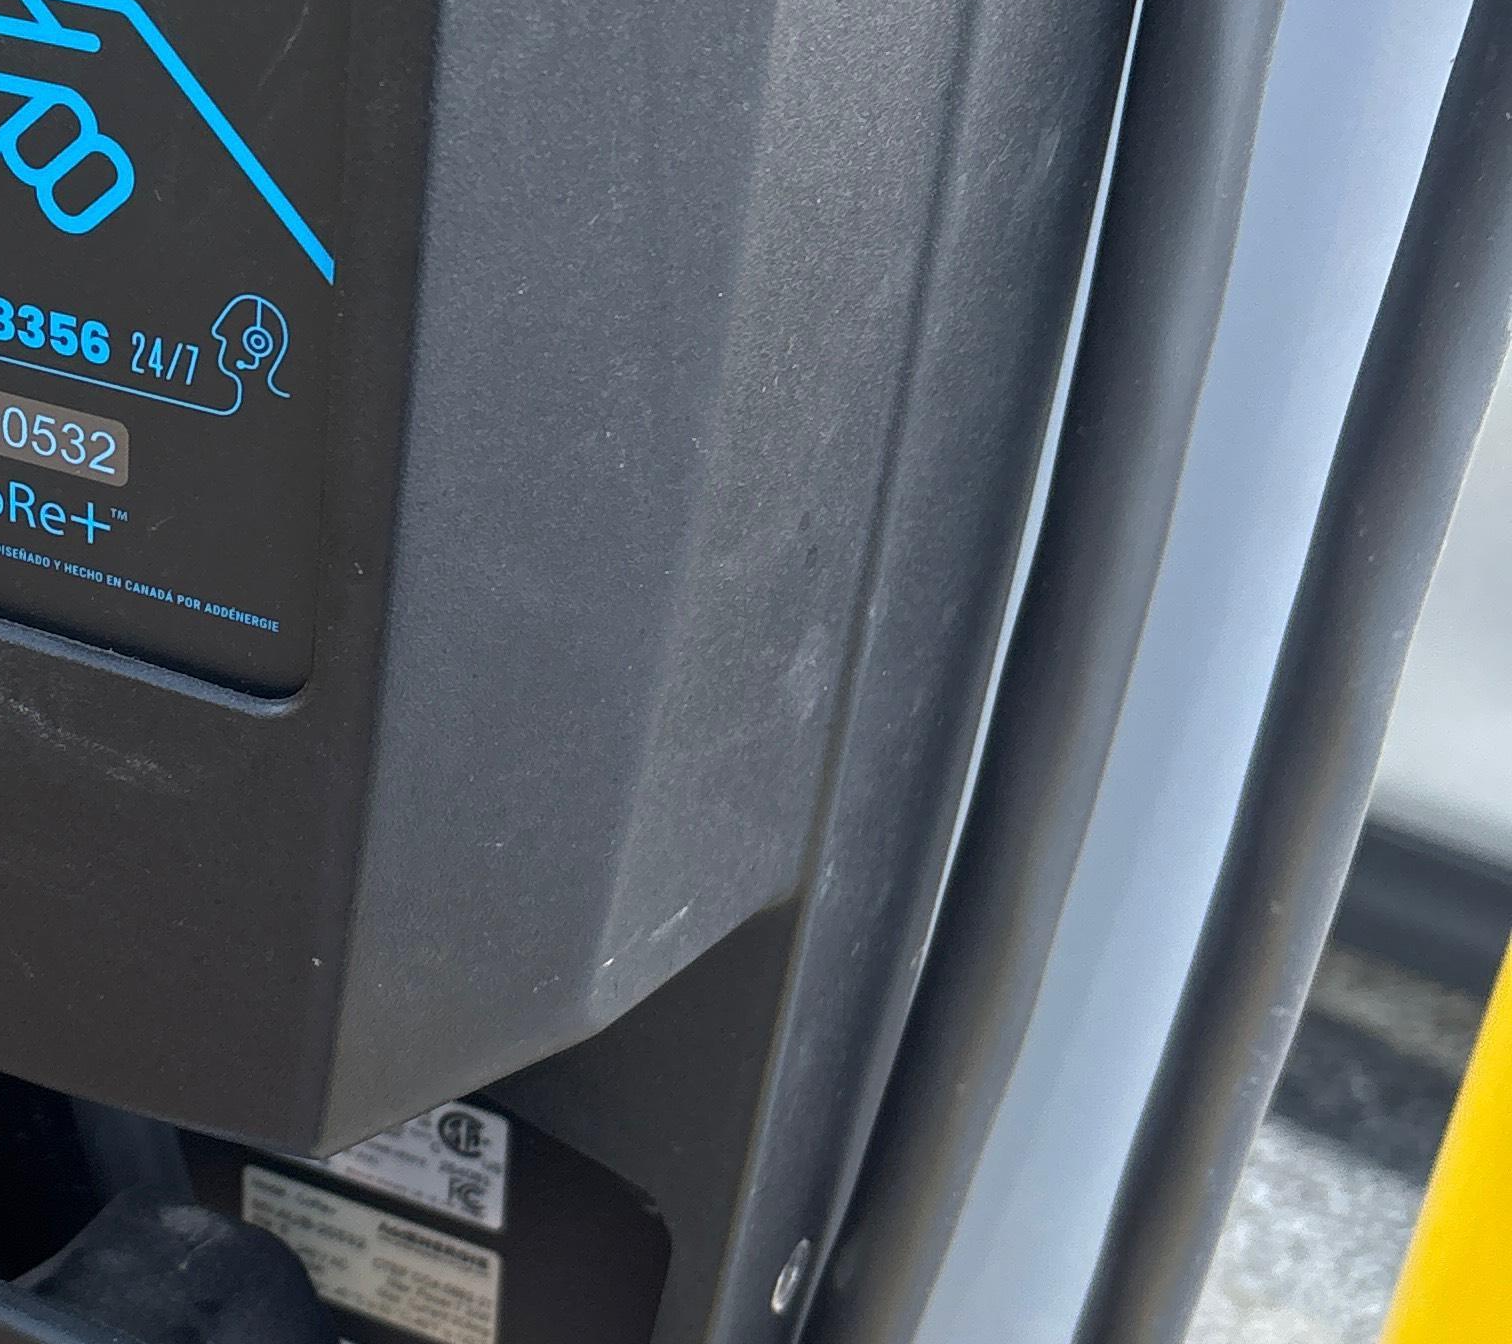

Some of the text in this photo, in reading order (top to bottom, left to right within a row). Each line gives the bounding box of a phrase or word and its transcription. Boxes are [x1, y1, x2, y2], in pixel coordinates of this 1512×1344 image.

[130, 332, 200, 386] 24/7
[53, 559, 62, 571] Y
[63, 563, 104, 583] HECHO
[106, 575, 122, 588] EN
[124, 580, 173, 603] CANADÁ
[176, 594, 201, 610] POR
